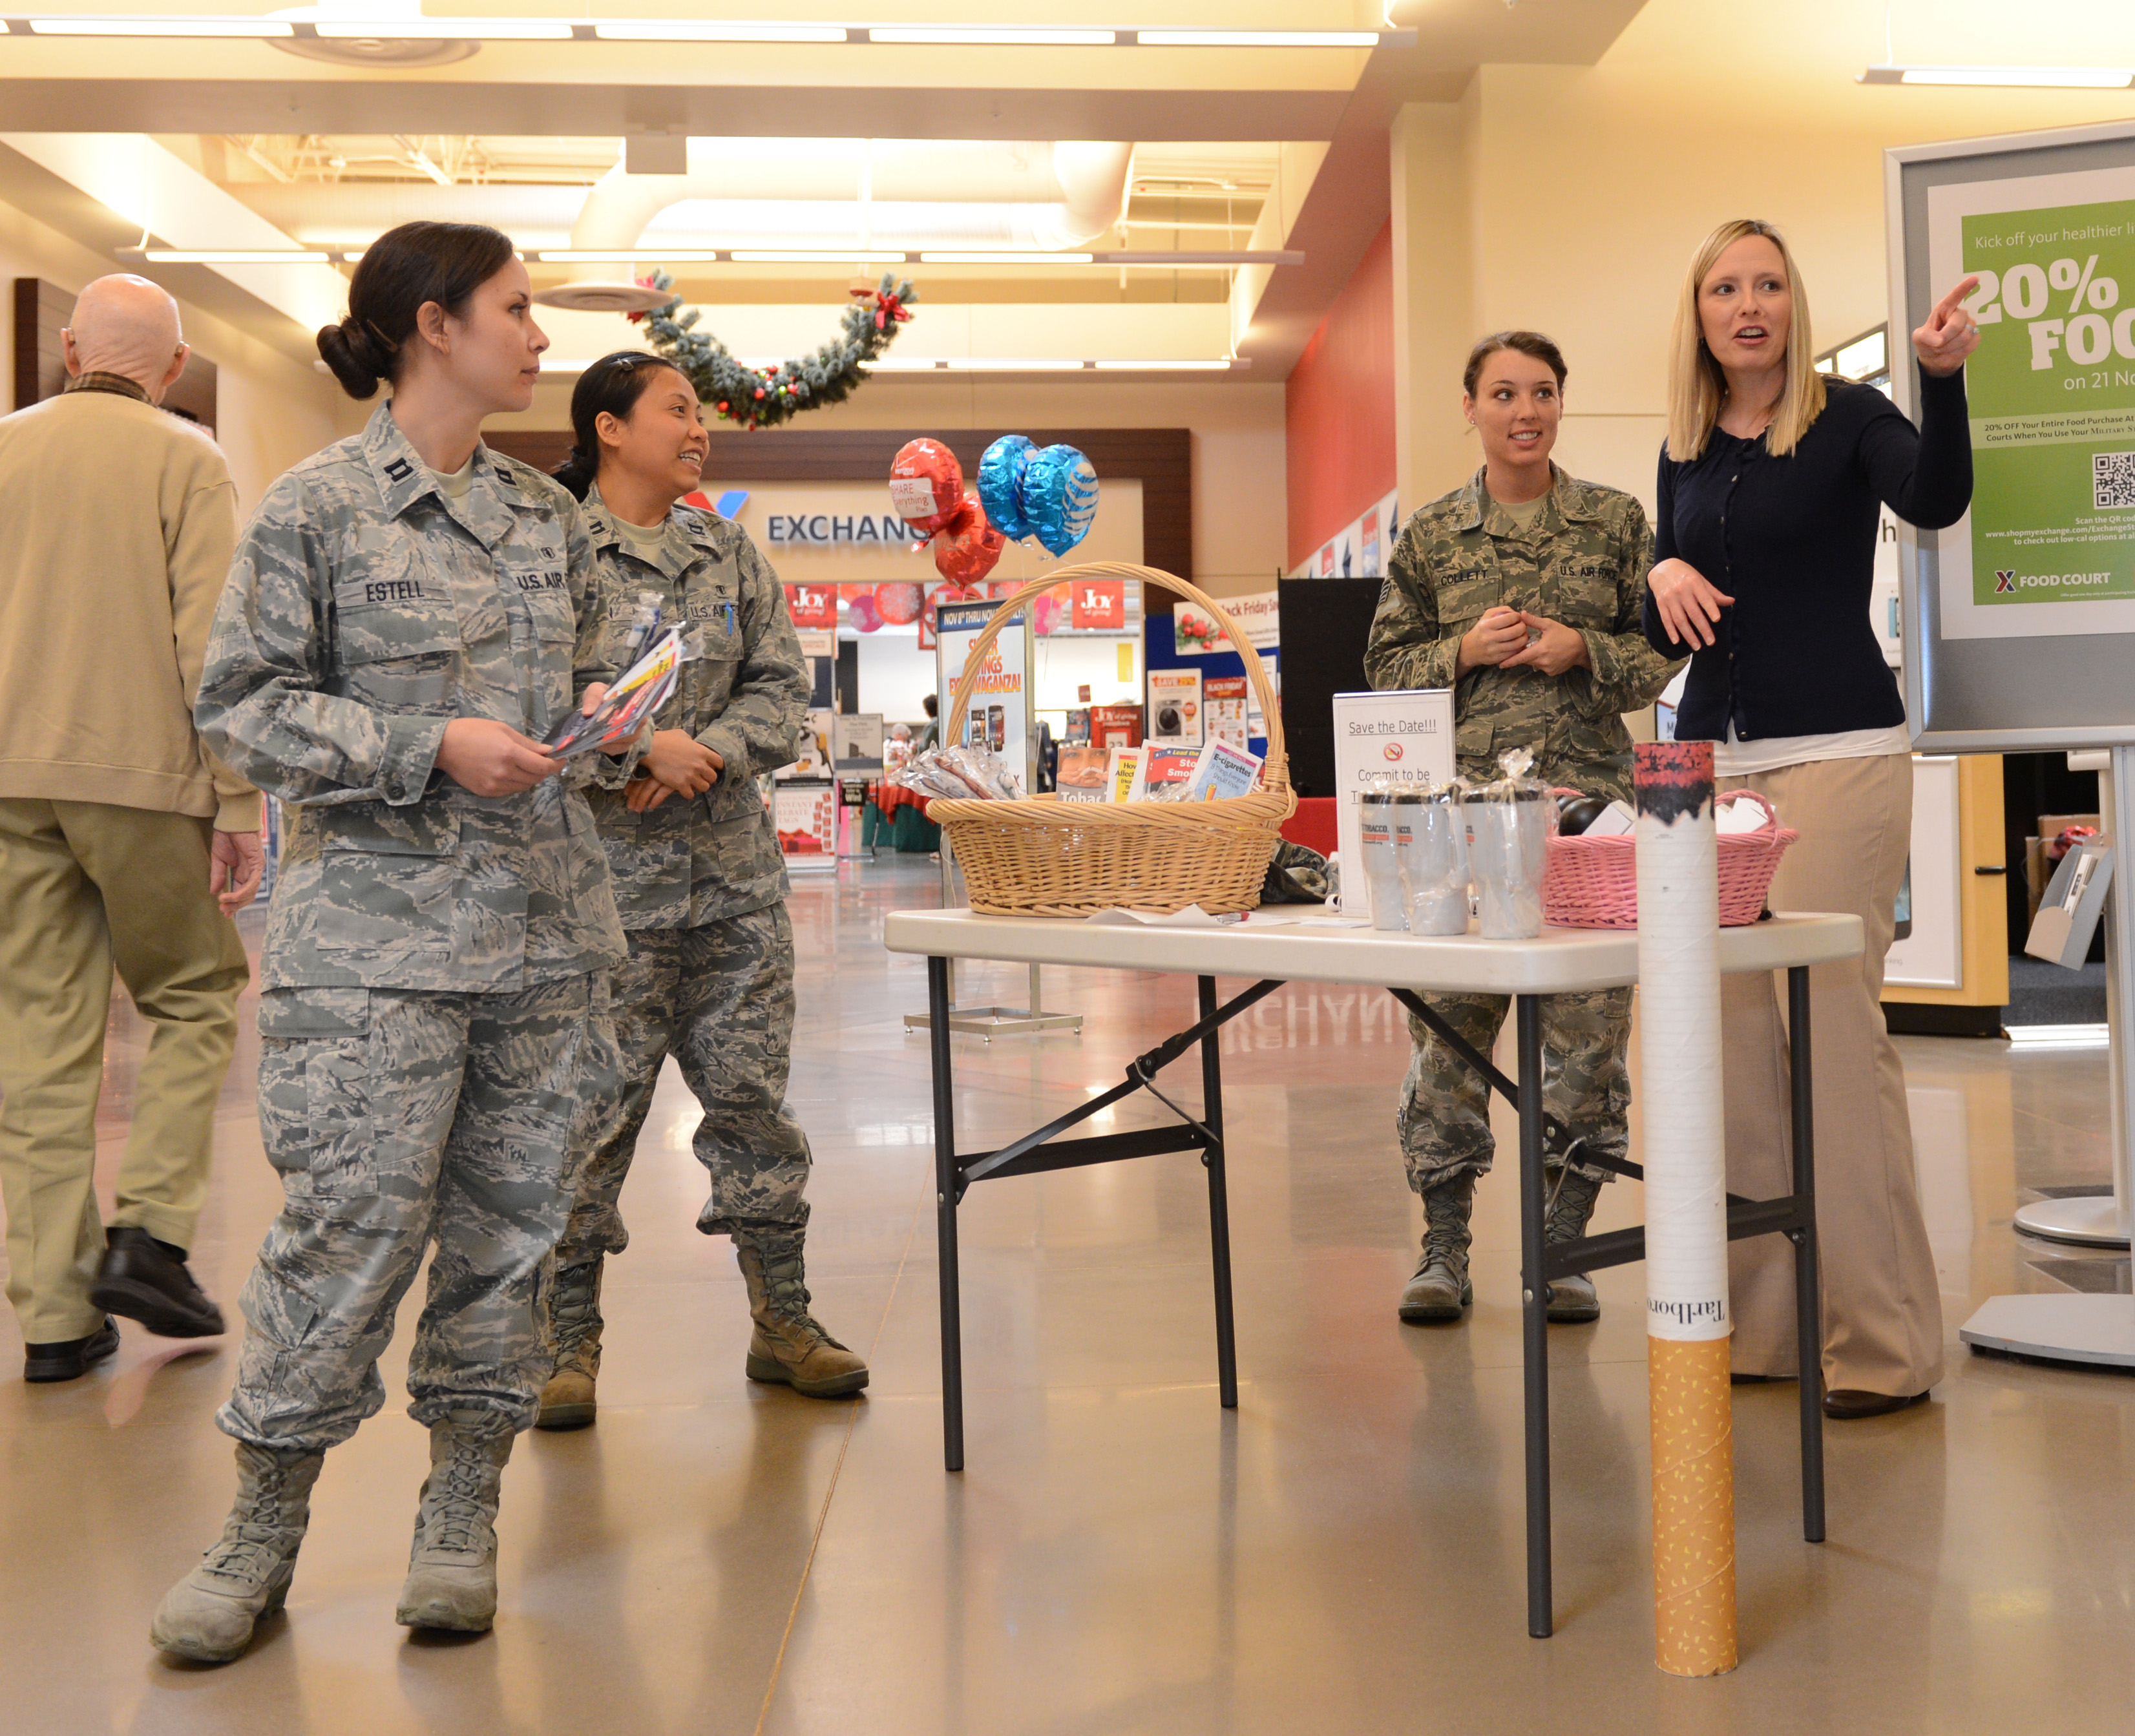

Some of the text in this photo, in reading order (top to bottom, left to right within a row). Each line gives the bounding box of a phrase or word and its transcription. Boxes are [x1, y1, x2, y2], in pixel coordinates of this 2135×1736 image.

[1975, 235, 2002, 249] Kick
[2006, 231, 2026, 246] off
[2028, 232, 2059, 247] your
[2063, 224, 2123, 240] healthier
[1962, 255, 2119, 326] 20%
[2064, 377, 2086, 390] on
[2092, 371, 2109, 388] 21
[2109, 515, 2121, 523] QR
[2060, 534, 2087, 543] low-cal
[2088, 534, 2117, 543] options
[516, 574, 543, 591] U.S.
[544, 572, 565, 589] AIR
[1440, 569, 1488, 587] COLLETT
[1560, 566, 1619, 581] U.S. AIR FORCE
[2020, 575, 2060, 587] FOOD
[2062, 572, 2111, 586] COURT
[365, 581, 425, 603] ESTELL
[690, 605, 710, 618] U.S.
[1243, 600, 1268, 616] Friday
[943, 612, 957, 625] NOV
[965, 609, 982, 623] THRU
[1349, 719, 1436, 734] Save the Date!!!
[1214, 753, 1252, 777] E-cigarettes
[1358, 768, 1430, 782] Commit to be
